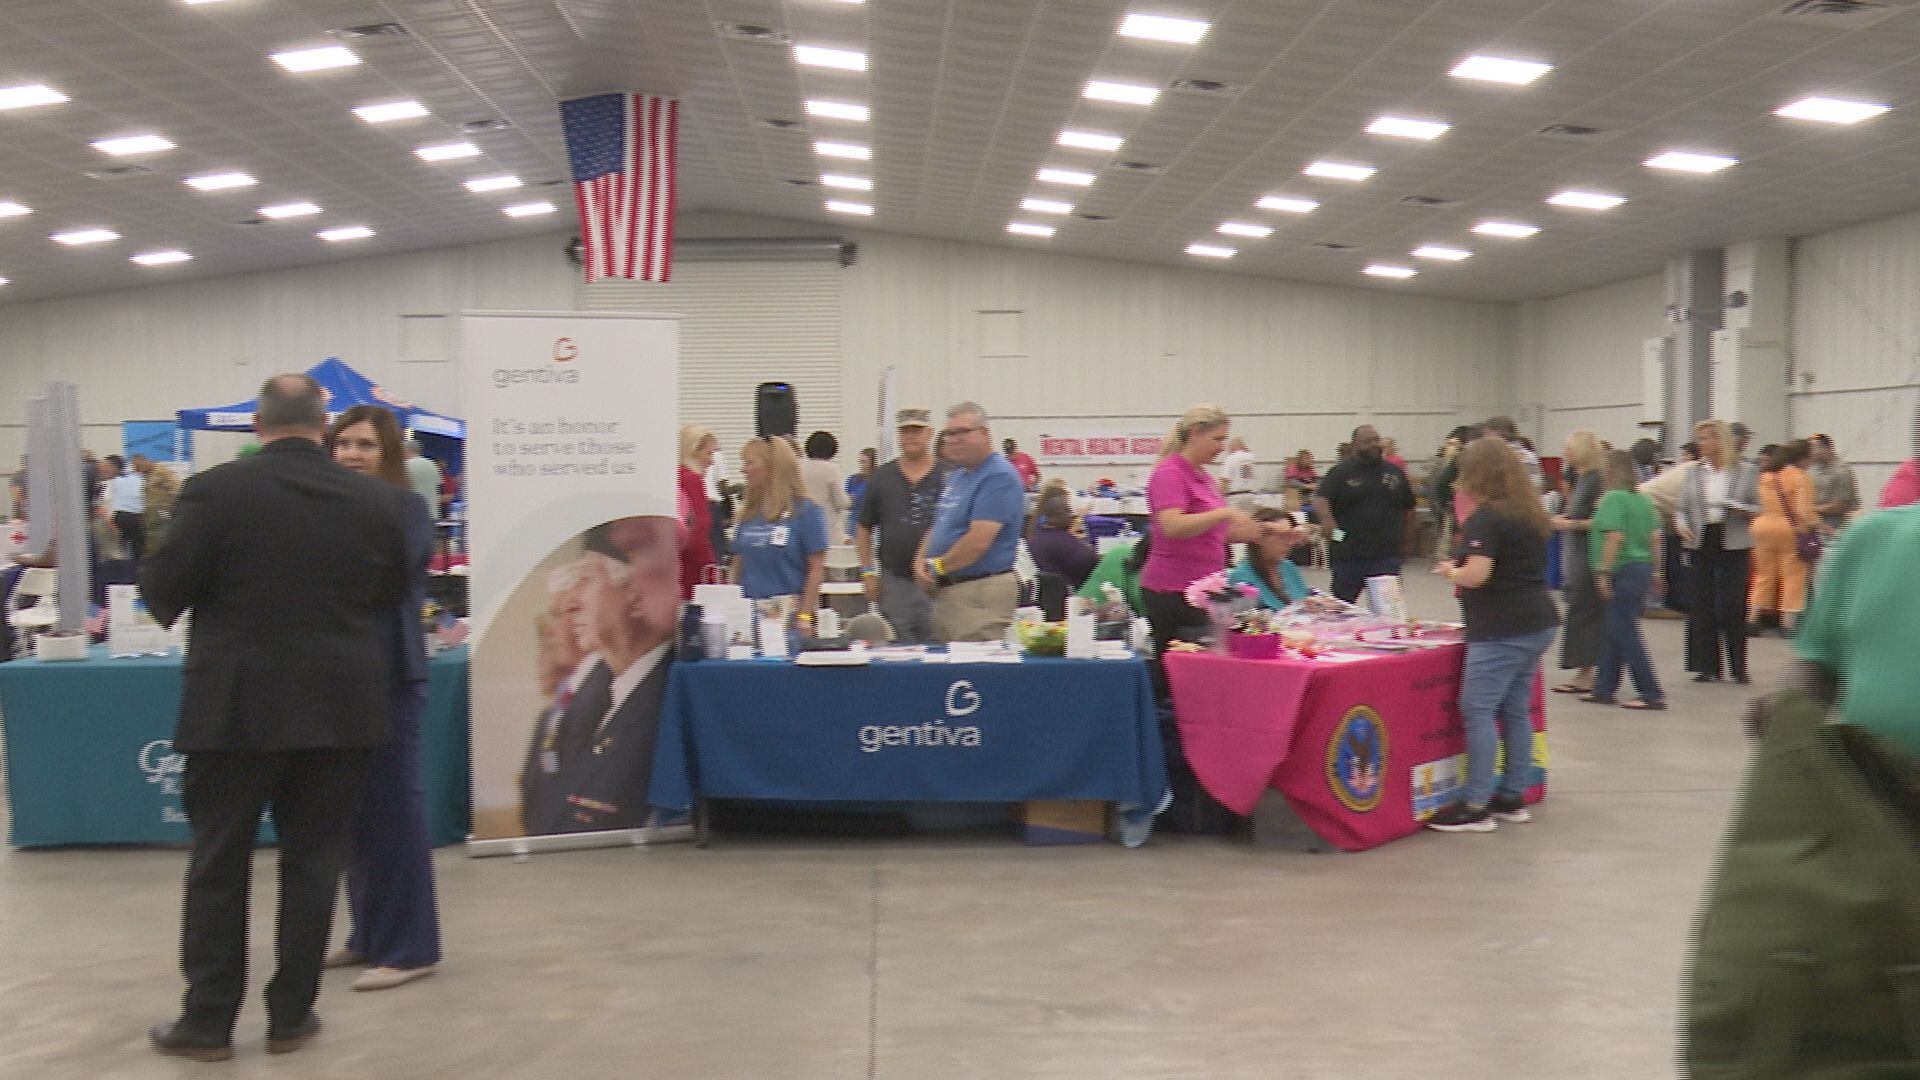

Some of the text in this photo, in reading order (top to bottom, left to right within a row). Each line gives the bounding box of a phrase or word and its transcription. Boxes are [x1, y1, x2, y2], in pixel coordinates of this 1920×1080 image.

[493, 365, 580, 389] gentiva
[493, 417, 621, 436] It's an honor
[493, 437, 639, 456] to serve those
[1040, 437, 1163, 456] MENTAL HEALTH ASSO
[493, 458, 638, 477] who served us
[858, 718, 982, 753] gentiva
